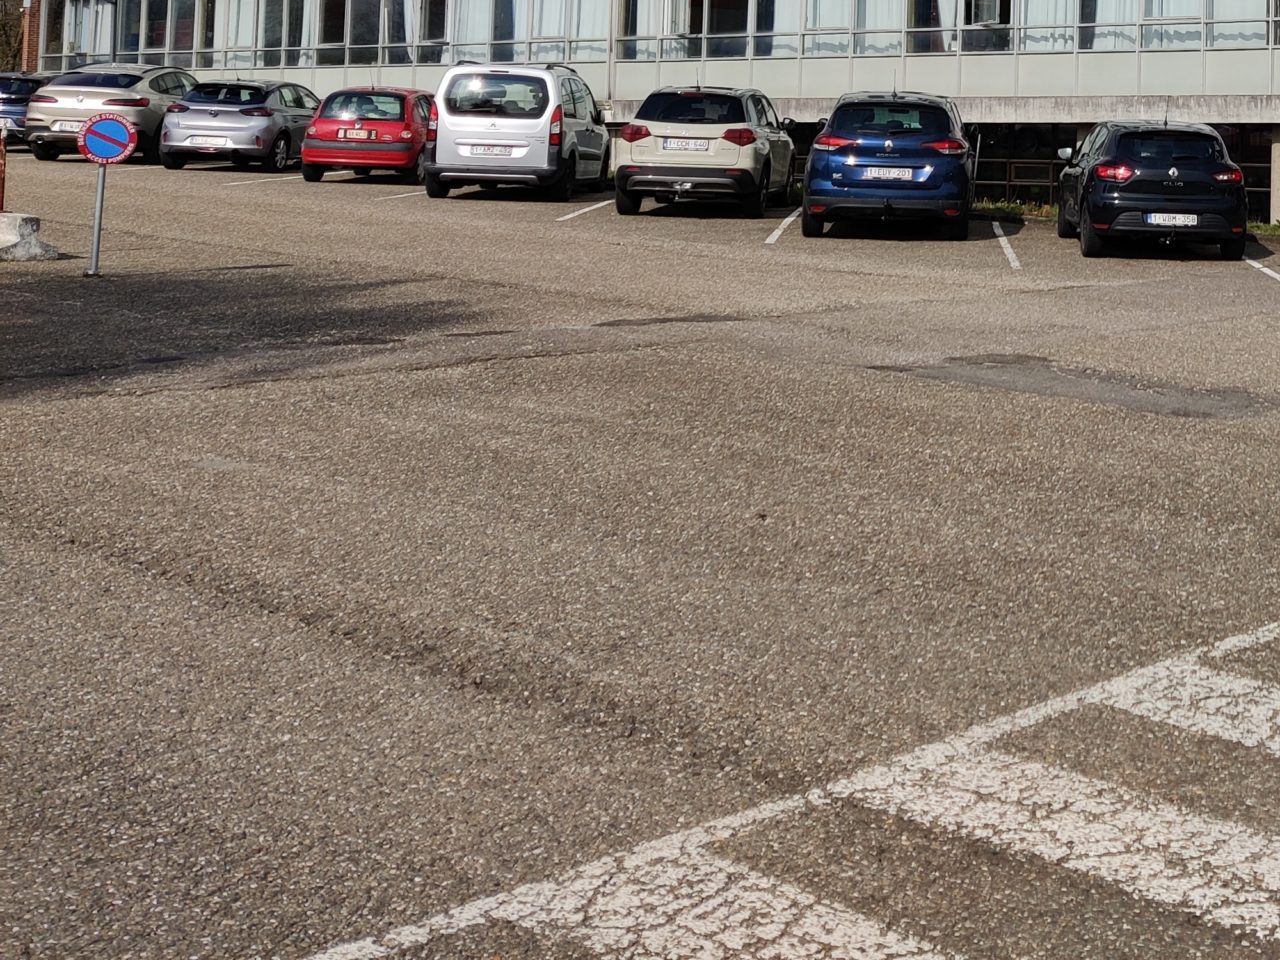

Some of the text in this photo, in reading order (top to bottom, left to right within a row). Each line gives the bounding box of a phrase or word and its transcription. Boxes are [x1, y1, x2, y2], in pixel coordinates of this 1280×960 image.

[101, 114, 135, 133] STATIONNER
[869, 168, 911, 177] 1-EDY-201
[1153, 214, 1197, 224] 1-WBM-358
